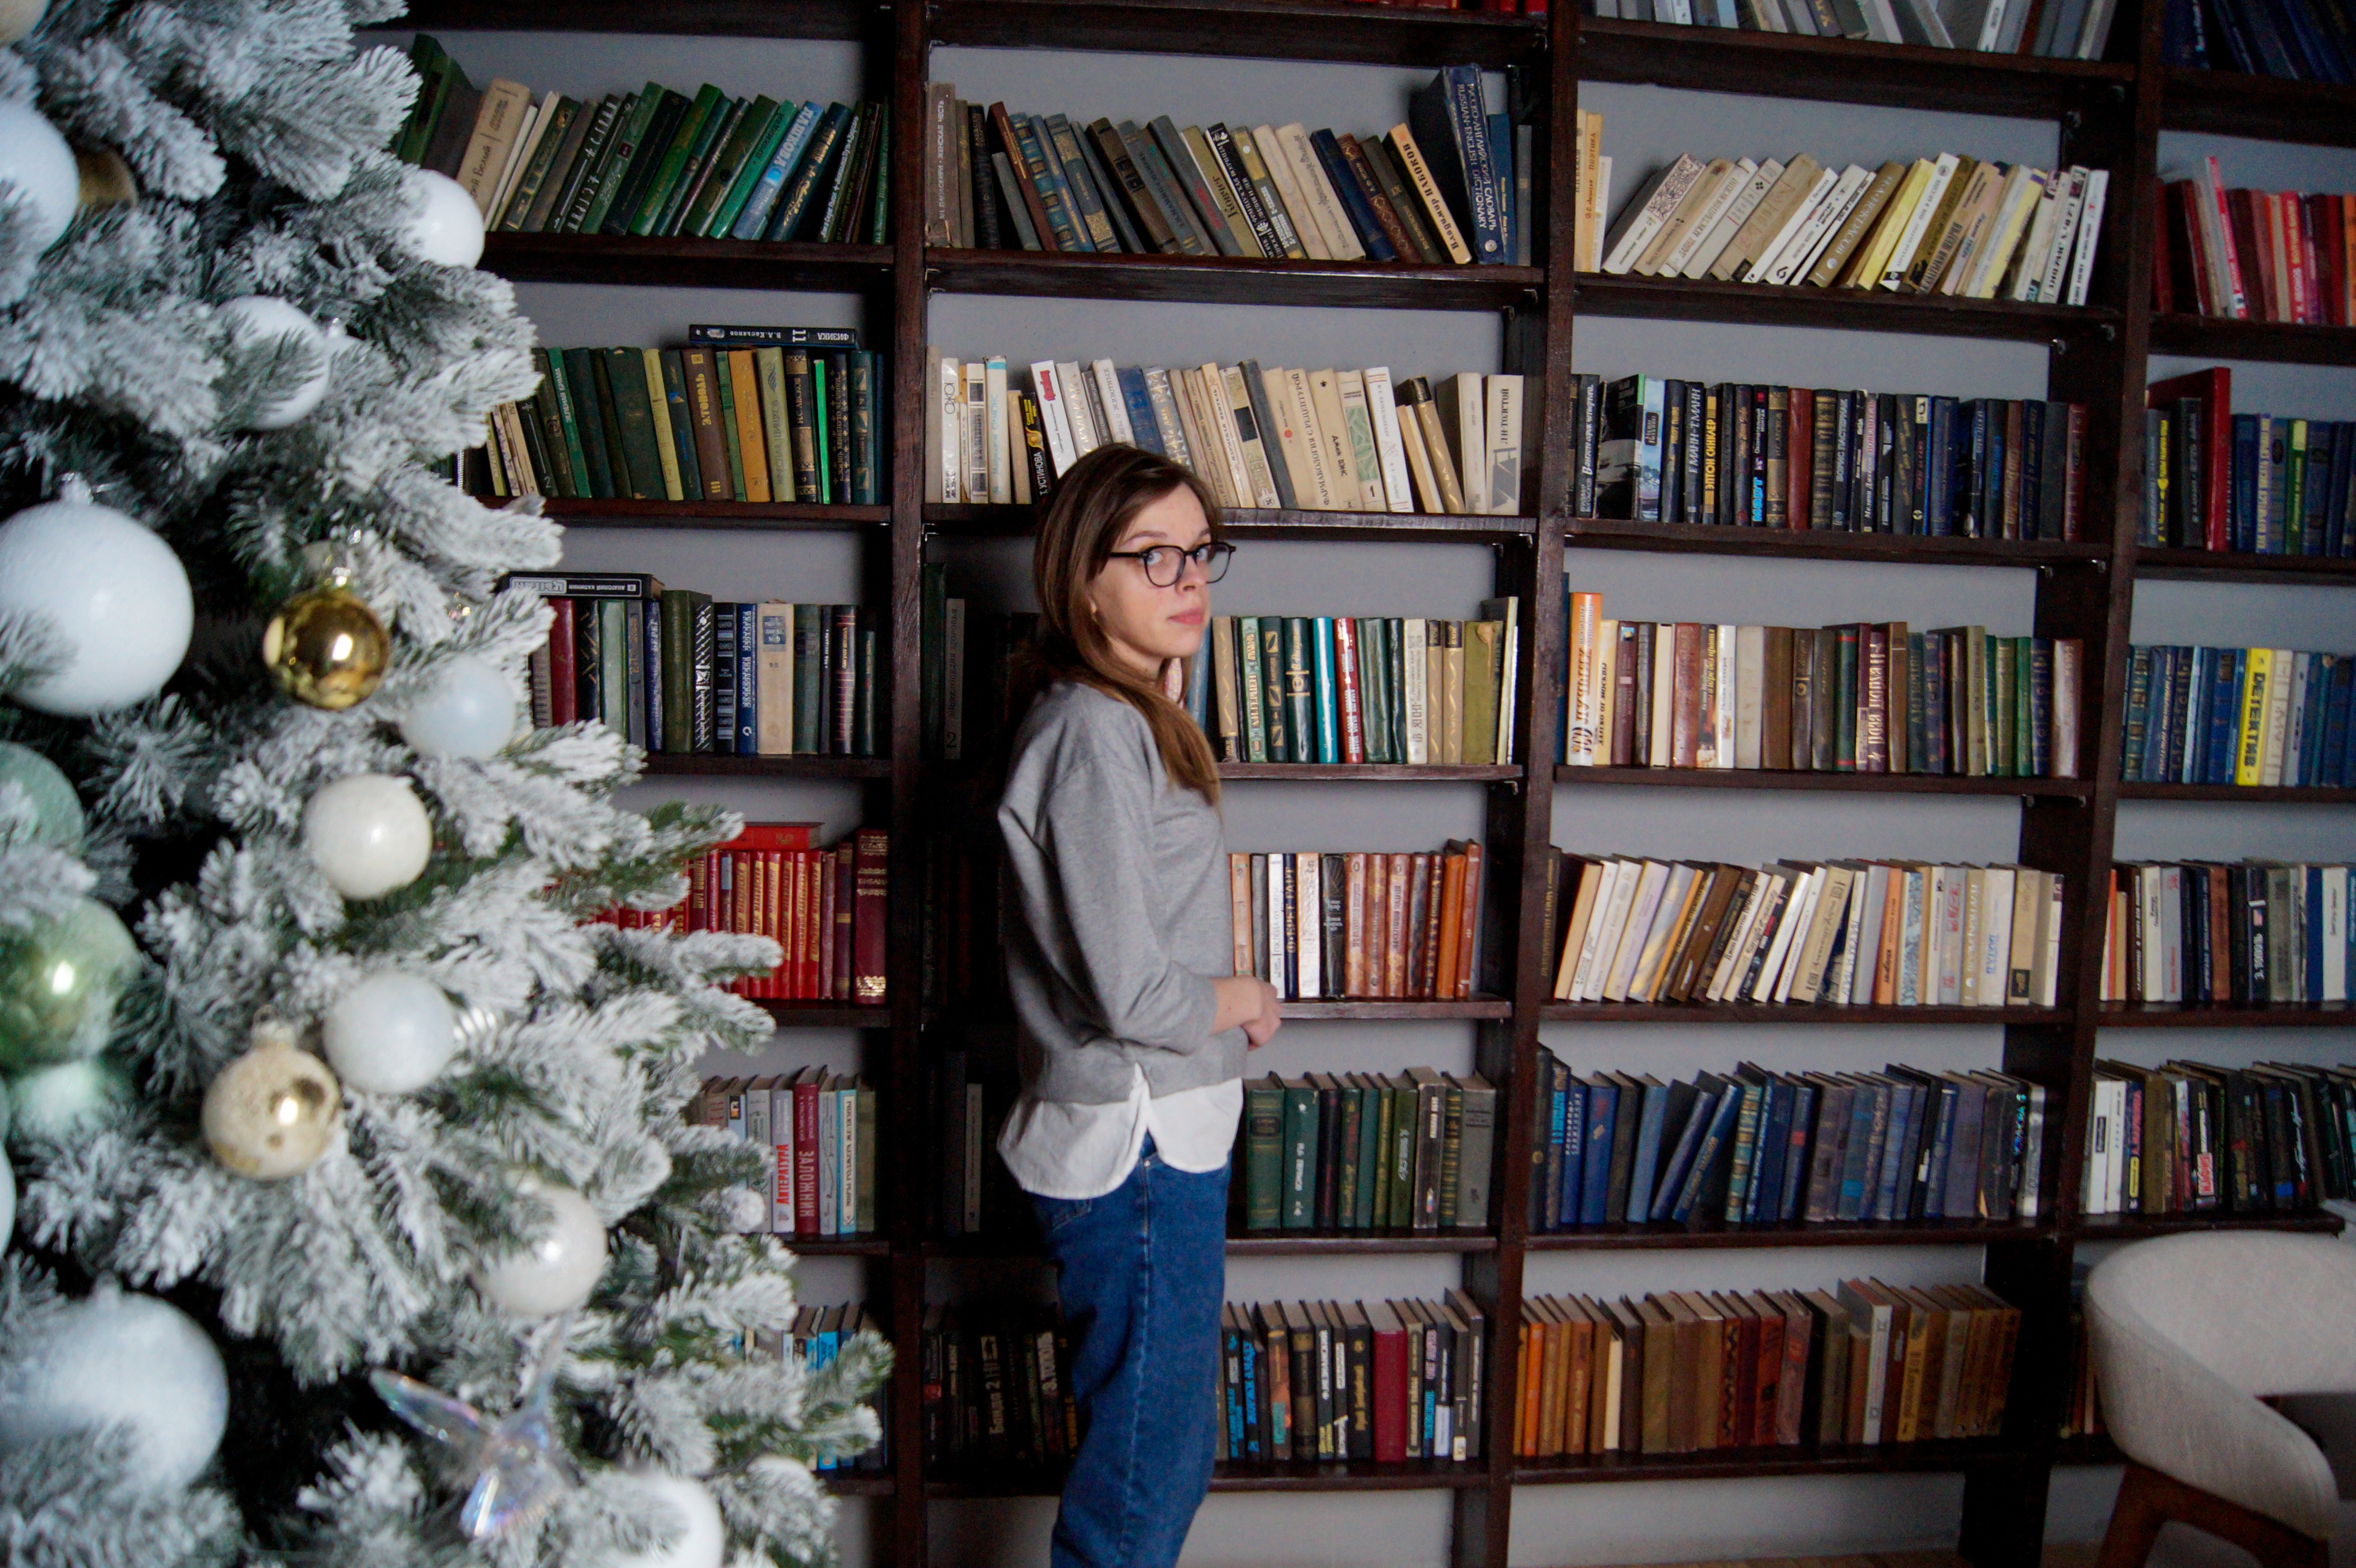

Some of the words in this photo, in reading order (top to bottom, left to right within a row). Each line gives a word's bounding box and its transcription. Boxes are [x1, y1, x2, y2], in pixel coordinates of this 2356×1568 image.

[772, 105, 816, 168] ДАШКОВА
[1588, 132, 1597, 169] ПОЭТИКА
[472, 143, 492, 177] Белый
[1400, 142, 1434, 198] НАБОКОВ
[1457, 82, 1477, 166] RUSSIAN-ENGLISH
[1470, 168, 1487, 229] DICTIONARY
[1465, 82, 1492, 184] РУССКО-АНГЛИЙСКИЙ
[1482, 187, 1499, 231] СЛОВАРЬ
[1207, 173, 1240, 218] Ковчег
[1428, 196, 1462, 250] Владимир
[1676, 236, 1696, 259] ДАВИД
[793, 328, 806, 341] 11
[944, 383, 955, 414] ОЖОГ
[1102, 368, 1119, 411] ЖИВОТНЫХ
[1291, 373, 1311, 429] РЕЦЕПТУРОЙ
[1584, 423, 1593, 441] сорок
[1706, 419, 1717, 456] СИНКЛЕР
[1754, 408, 1762, 454] Окончательный
[1836, 398, 1849, 450] ПАСТЕРНАК
[773, 444, 785, 484] ВЯЧЕСЛАВ
[1032, 451, 1047, 488] УСТИНОВА
[1308, 437, 1330, 506] ФАРМАКОЛОГИЯ
[1331, 434, 1343, 456] Джек
[1337, 458, 1348, 477] ВЭНС
[1581, 466, 1593, 475] В
[1582, 442, 1593, 466] августе
[1834, 452, 1846, 481] БОРИС
[545, 476, 552, 489] 2
[1369, 485, 1375, 497] 1
[1704, 458, 1715, 489] ЭПТОН
[515, 581, 563, 591] ЦЫГАН
[1599, 663, 1608, 699] МОСКВЫ
[1599, 702, 1606, 711] ОТ
[946, 733, 957, 748] 2
[1723, 941, 1737, 961] Джон
